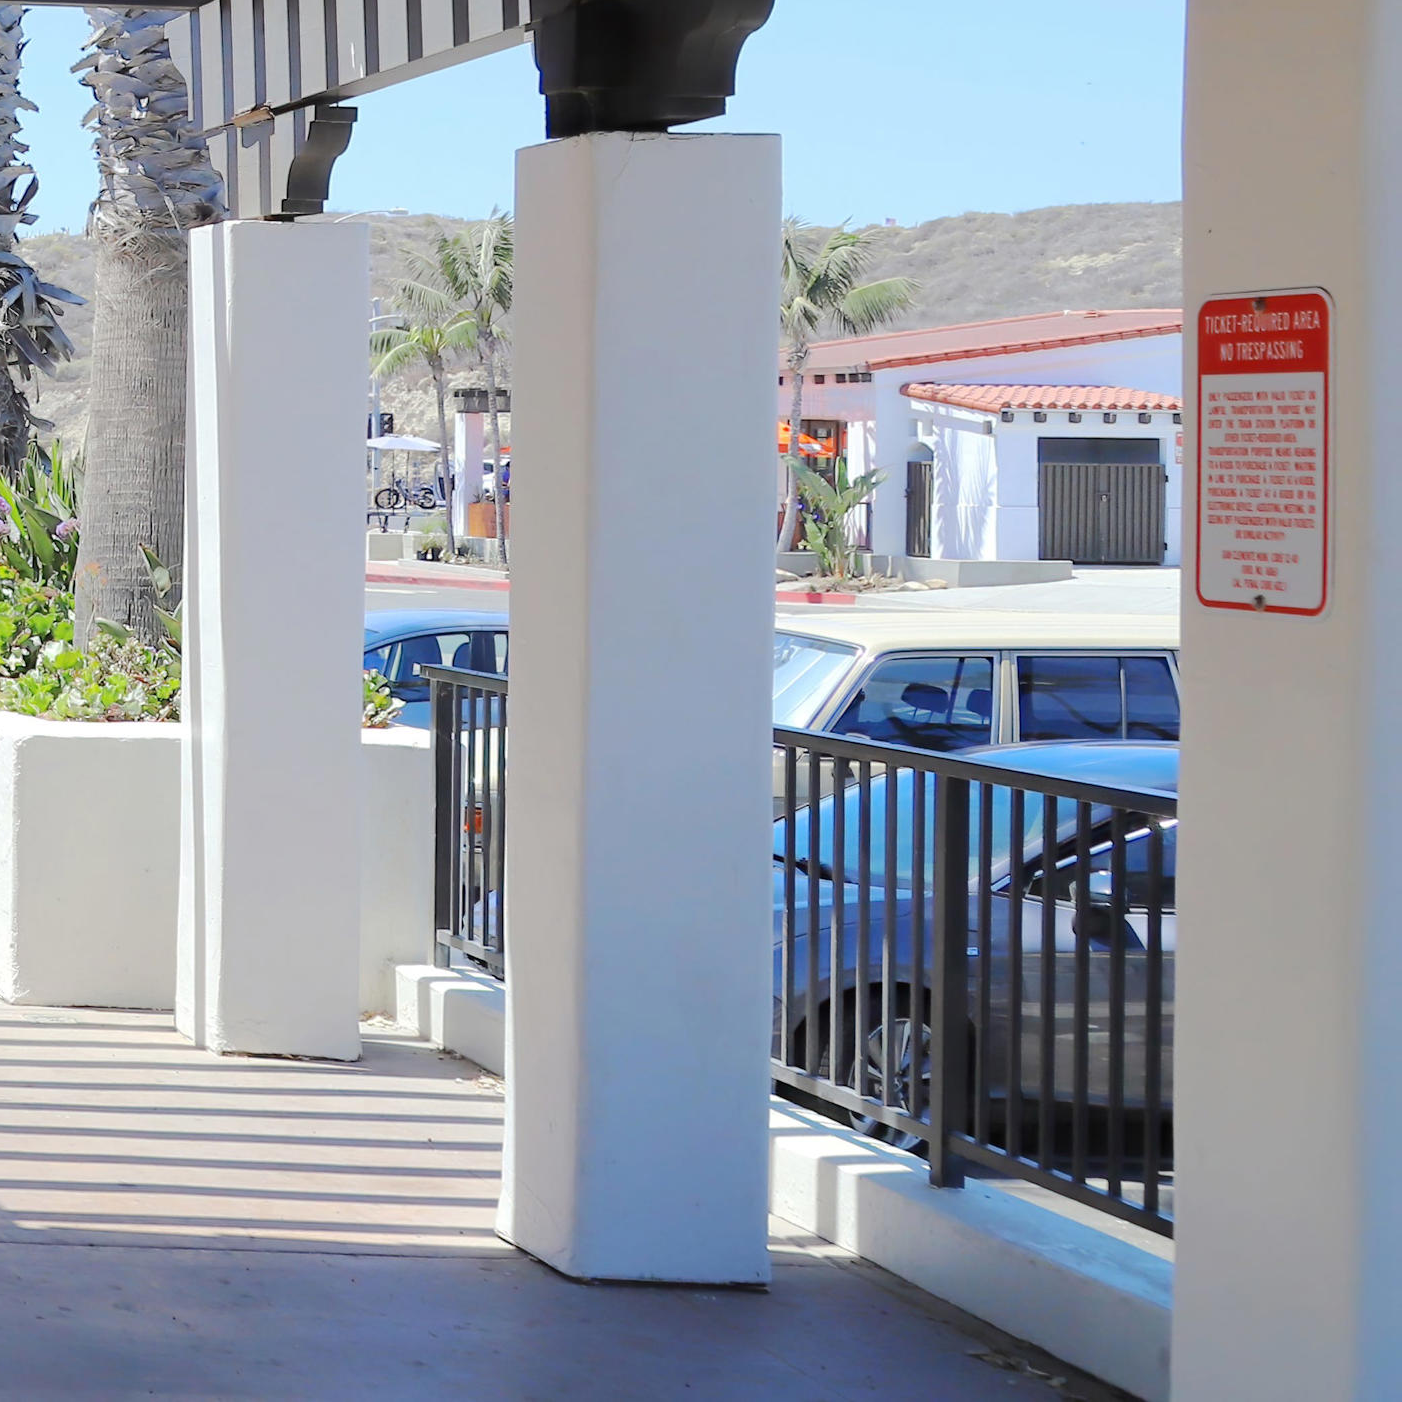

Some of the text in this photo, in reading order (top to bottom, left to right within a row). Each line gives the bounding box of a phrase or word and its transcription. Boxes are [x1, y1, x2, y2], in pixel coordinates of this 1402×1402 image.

[1293, 310, 1321, 330] AREA
[1220, 340, 1304, 361] NO TRESPASSING
